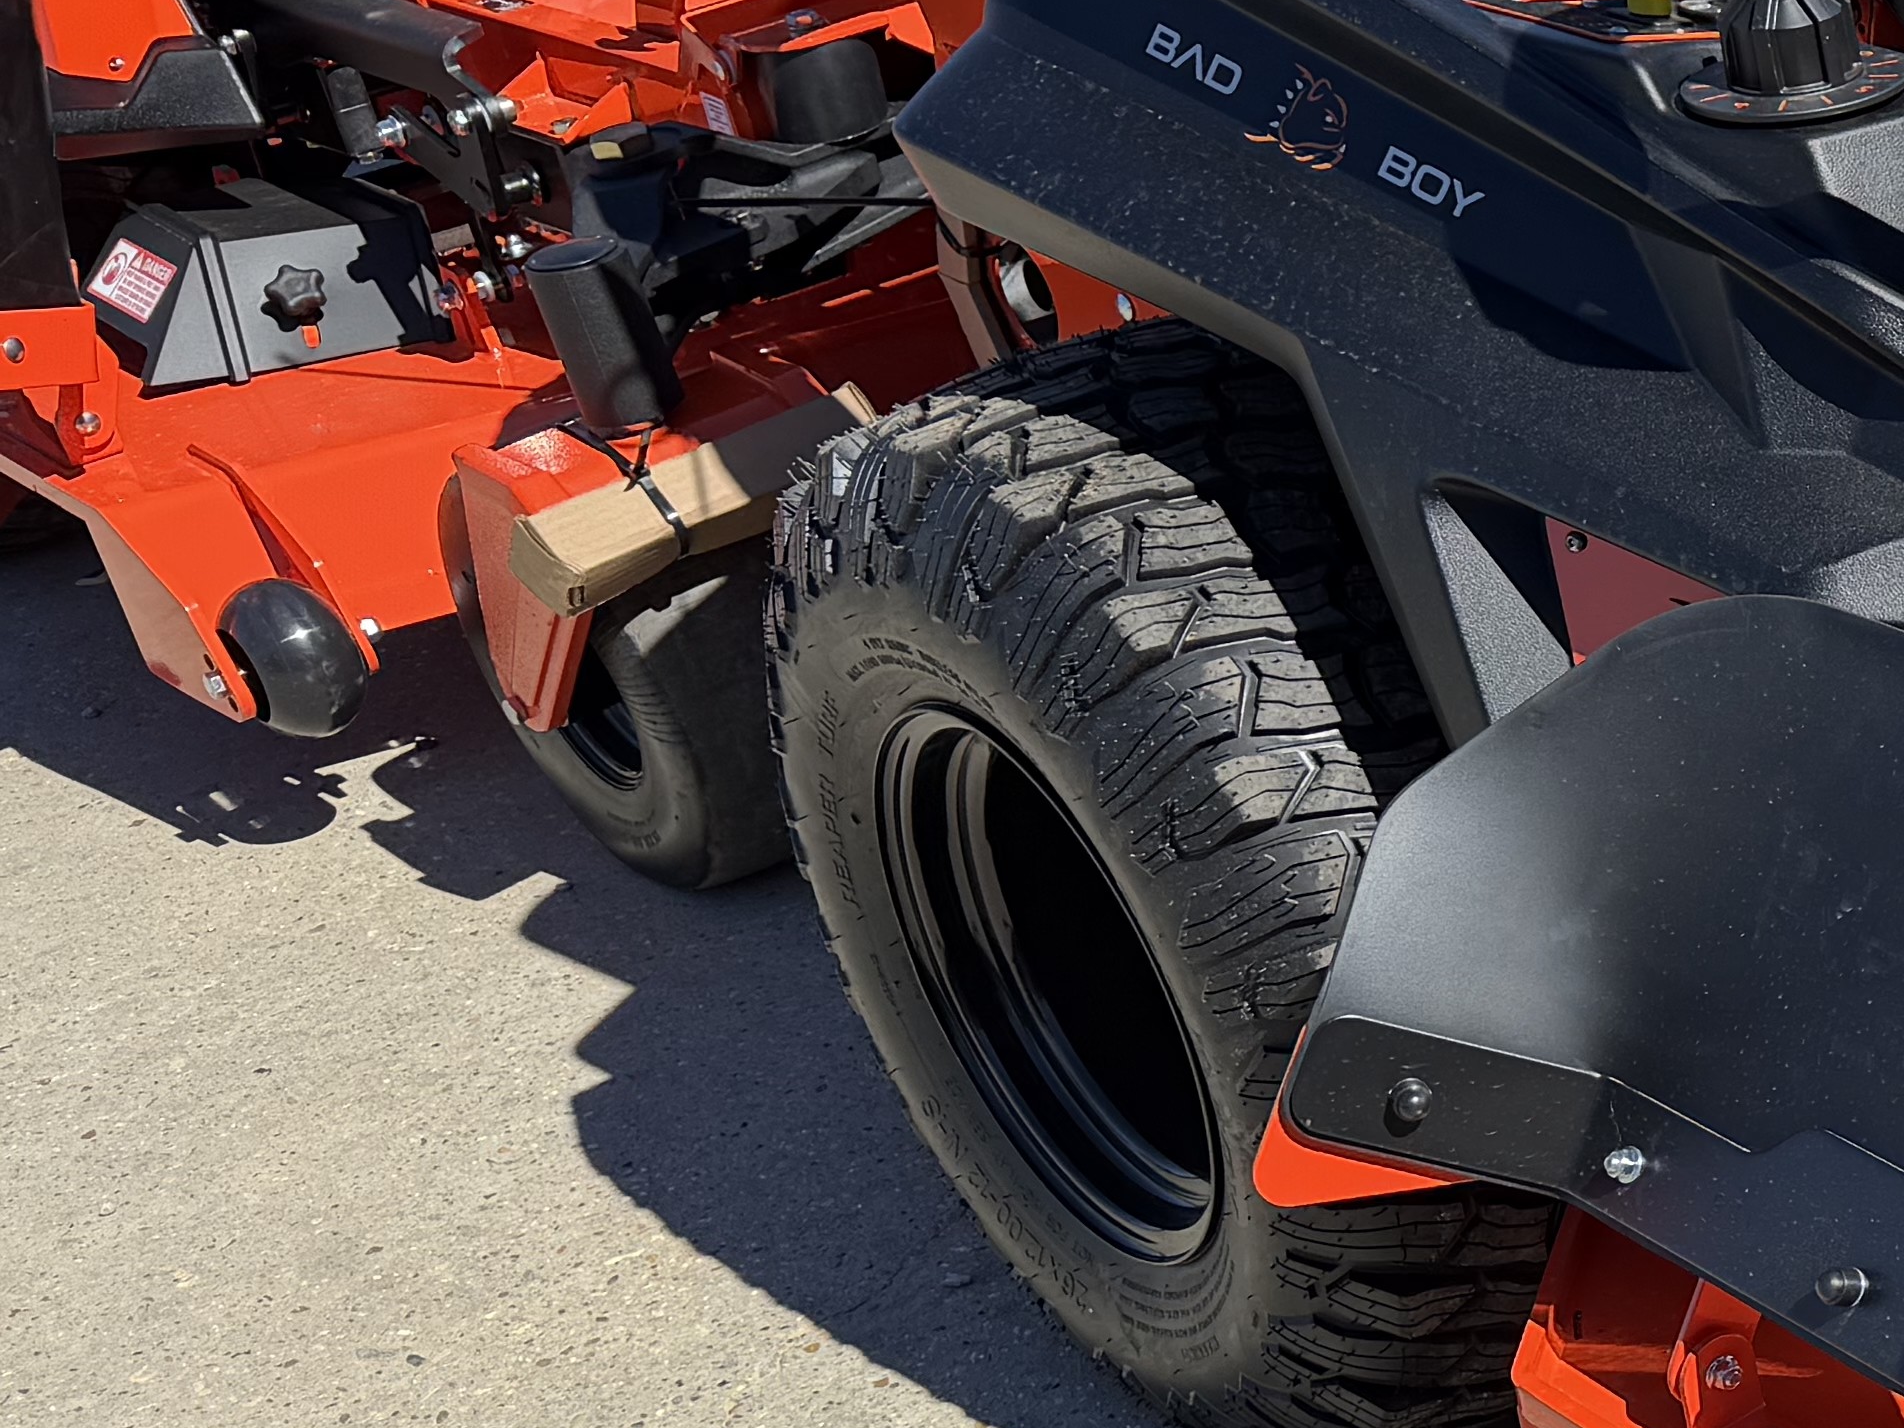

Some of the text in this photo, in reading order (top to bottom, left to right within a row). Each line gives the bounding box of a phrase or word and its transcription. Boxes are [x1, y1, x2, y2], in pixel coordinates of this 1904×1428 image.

[1144, 23, 1486, 219] BAD BOY
[815, 689, 859, 909] REAPER TURF
